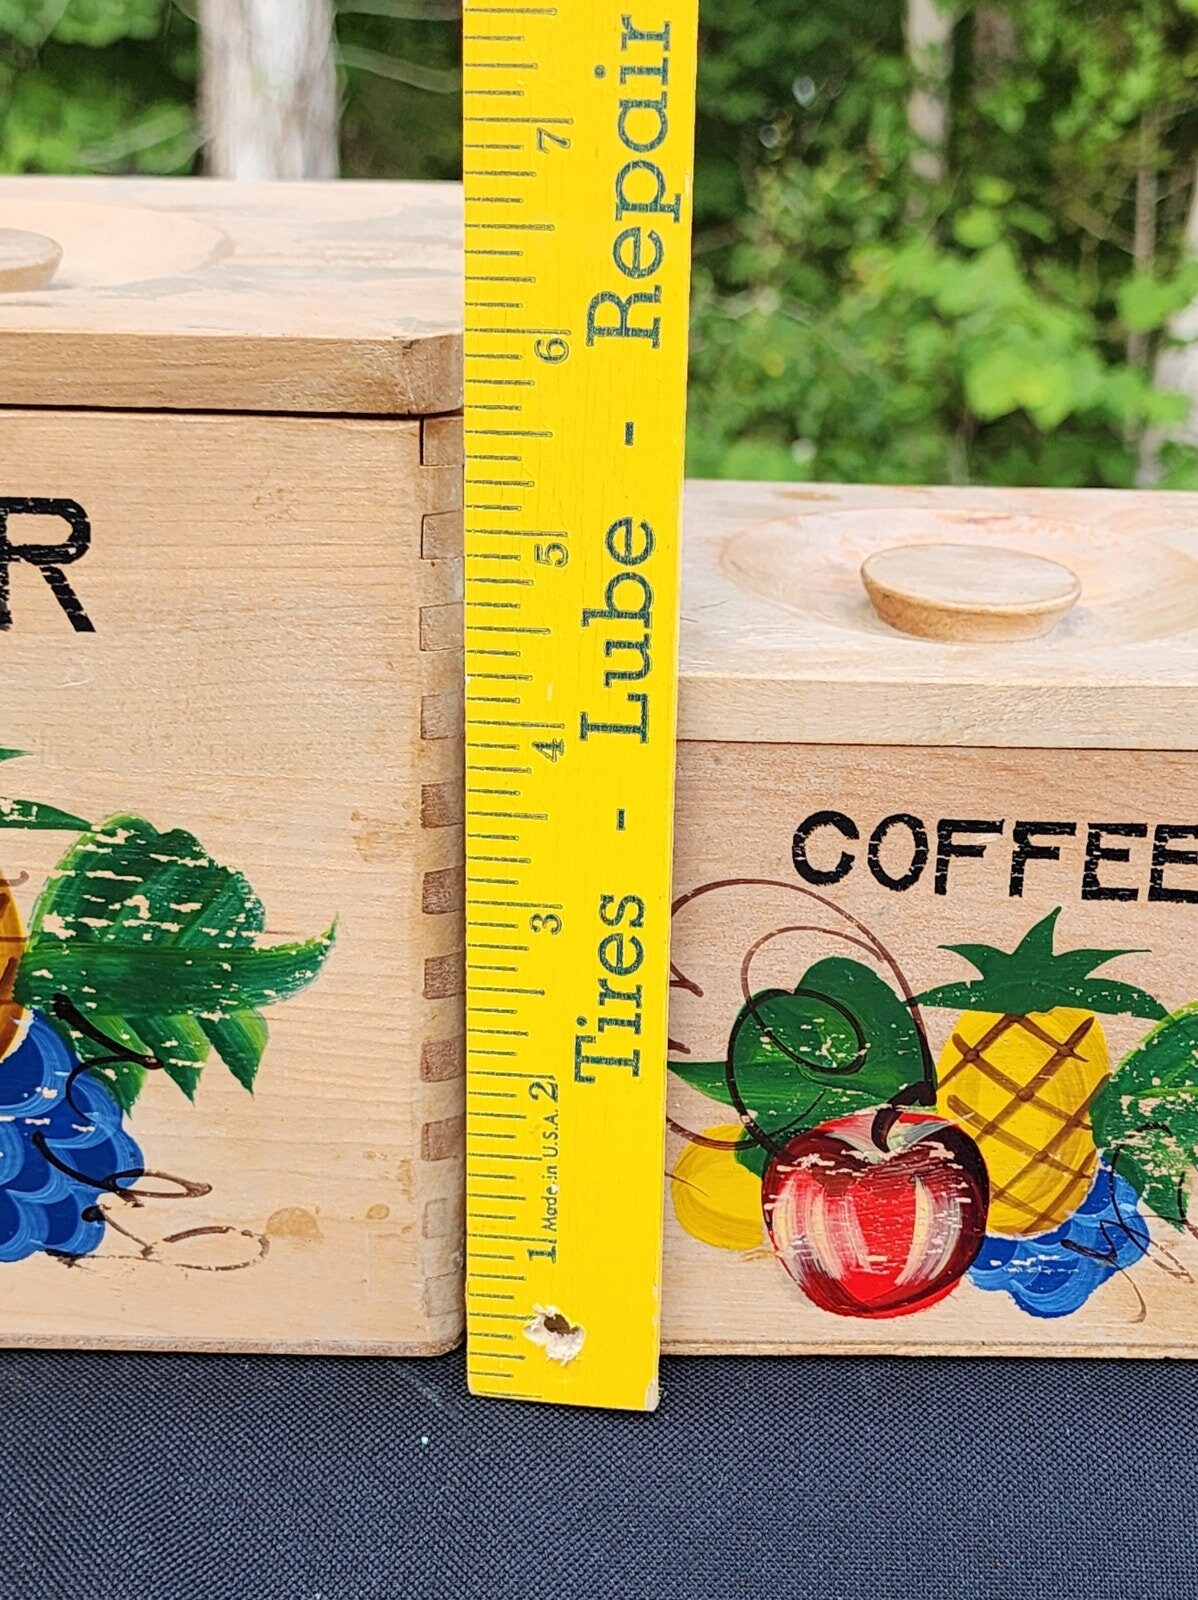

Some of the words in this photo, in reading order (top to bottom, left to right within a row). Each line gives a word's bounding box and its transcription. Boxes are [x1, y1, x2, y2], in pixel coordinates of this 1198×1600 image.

[535, 126, 572, 154] 7
[586, 13, 682, 349] Repair
[533, 337, 570, 364] 6
[534, 542, 569, 568] 5
[580, 516, 656, 744] Lube
[531, 737, 565, 763] 4
[791, 809, 1198, 903] COFFEE
[528, 913, 563, 936] 3
[573, 893, 646, 1084] Tires
[528, 1080, 559, 1104] 2
[541, 1108, 560, 1159] U.S.A.
[541, 1164, 558, 1182] in
[541, 1186, 558, 1232] Made
[527, 1246, 557, 1264] 1
